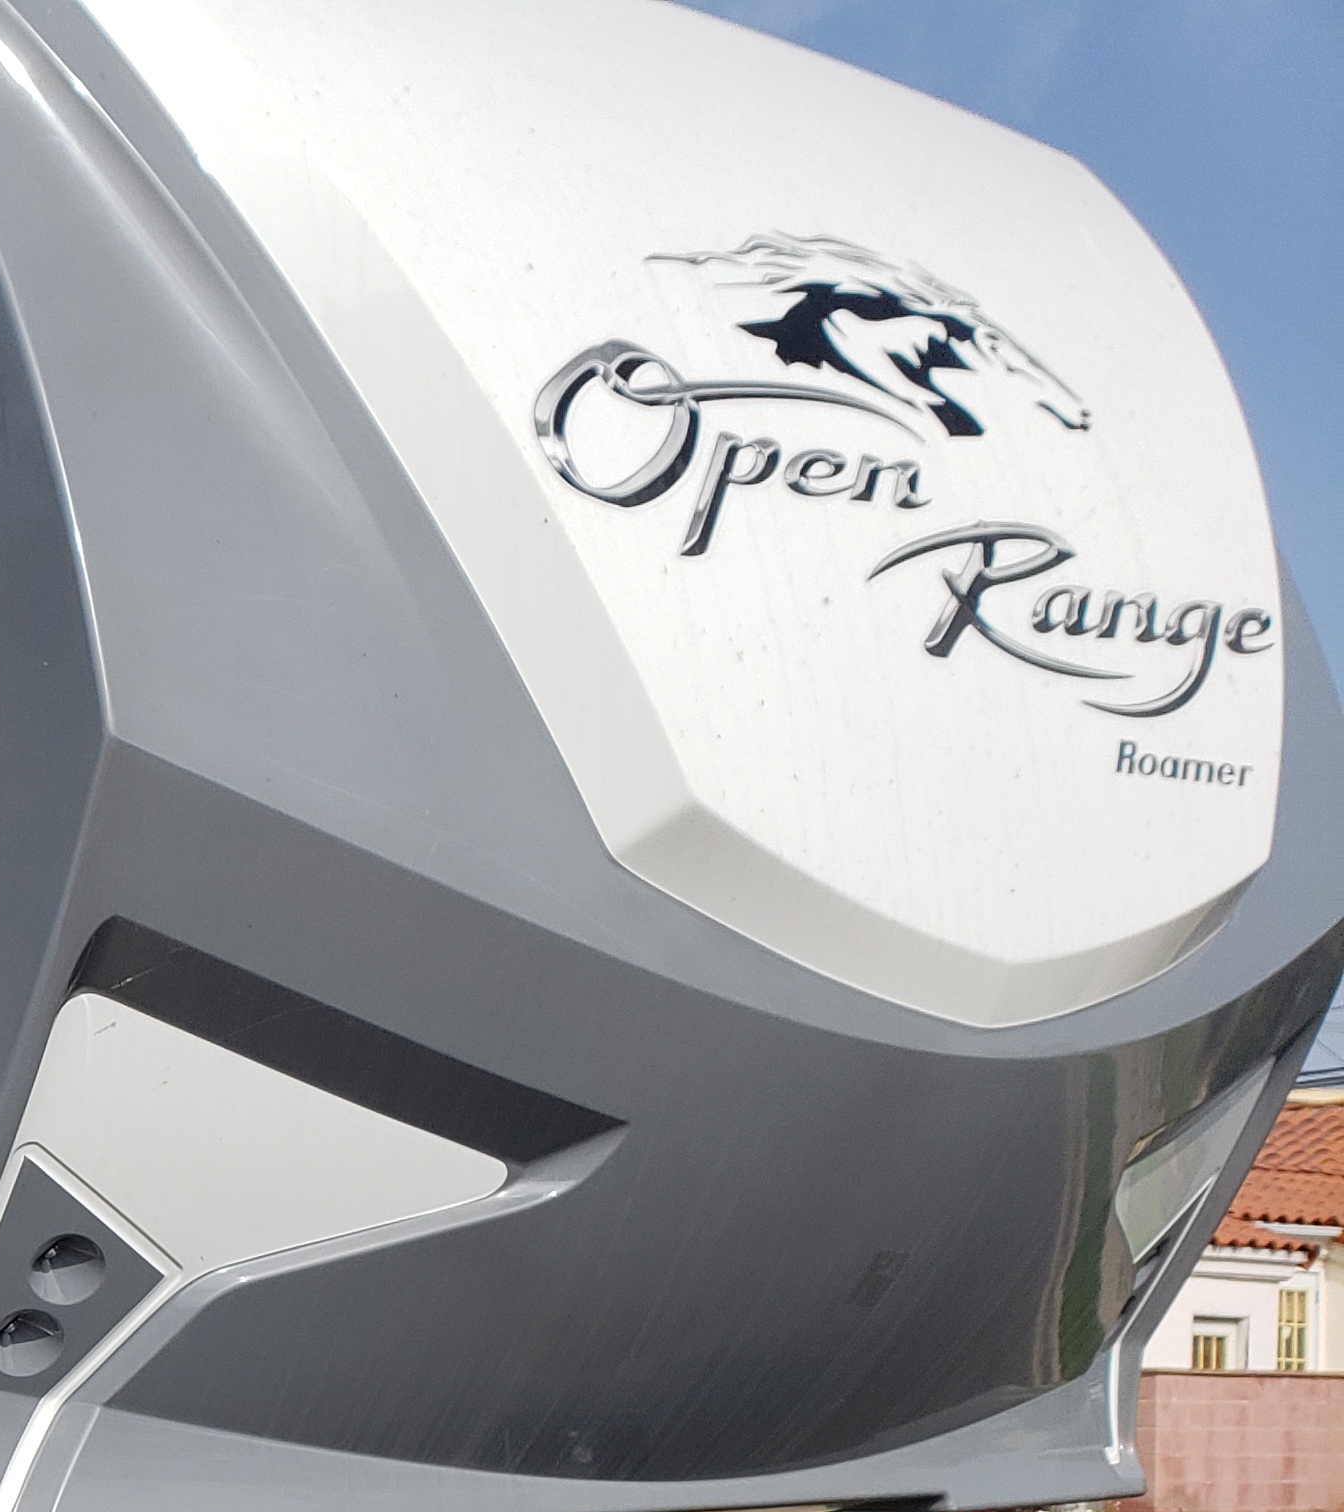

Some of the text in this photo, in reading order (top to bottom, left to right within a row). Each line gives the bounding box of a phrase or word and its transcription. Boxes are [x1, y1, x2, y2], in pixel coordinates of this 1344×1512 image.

[534, 338, 933, 556] Open
[867, 520, 1276, 718] Range
[1115, 739, 1253, 786] Roamer
